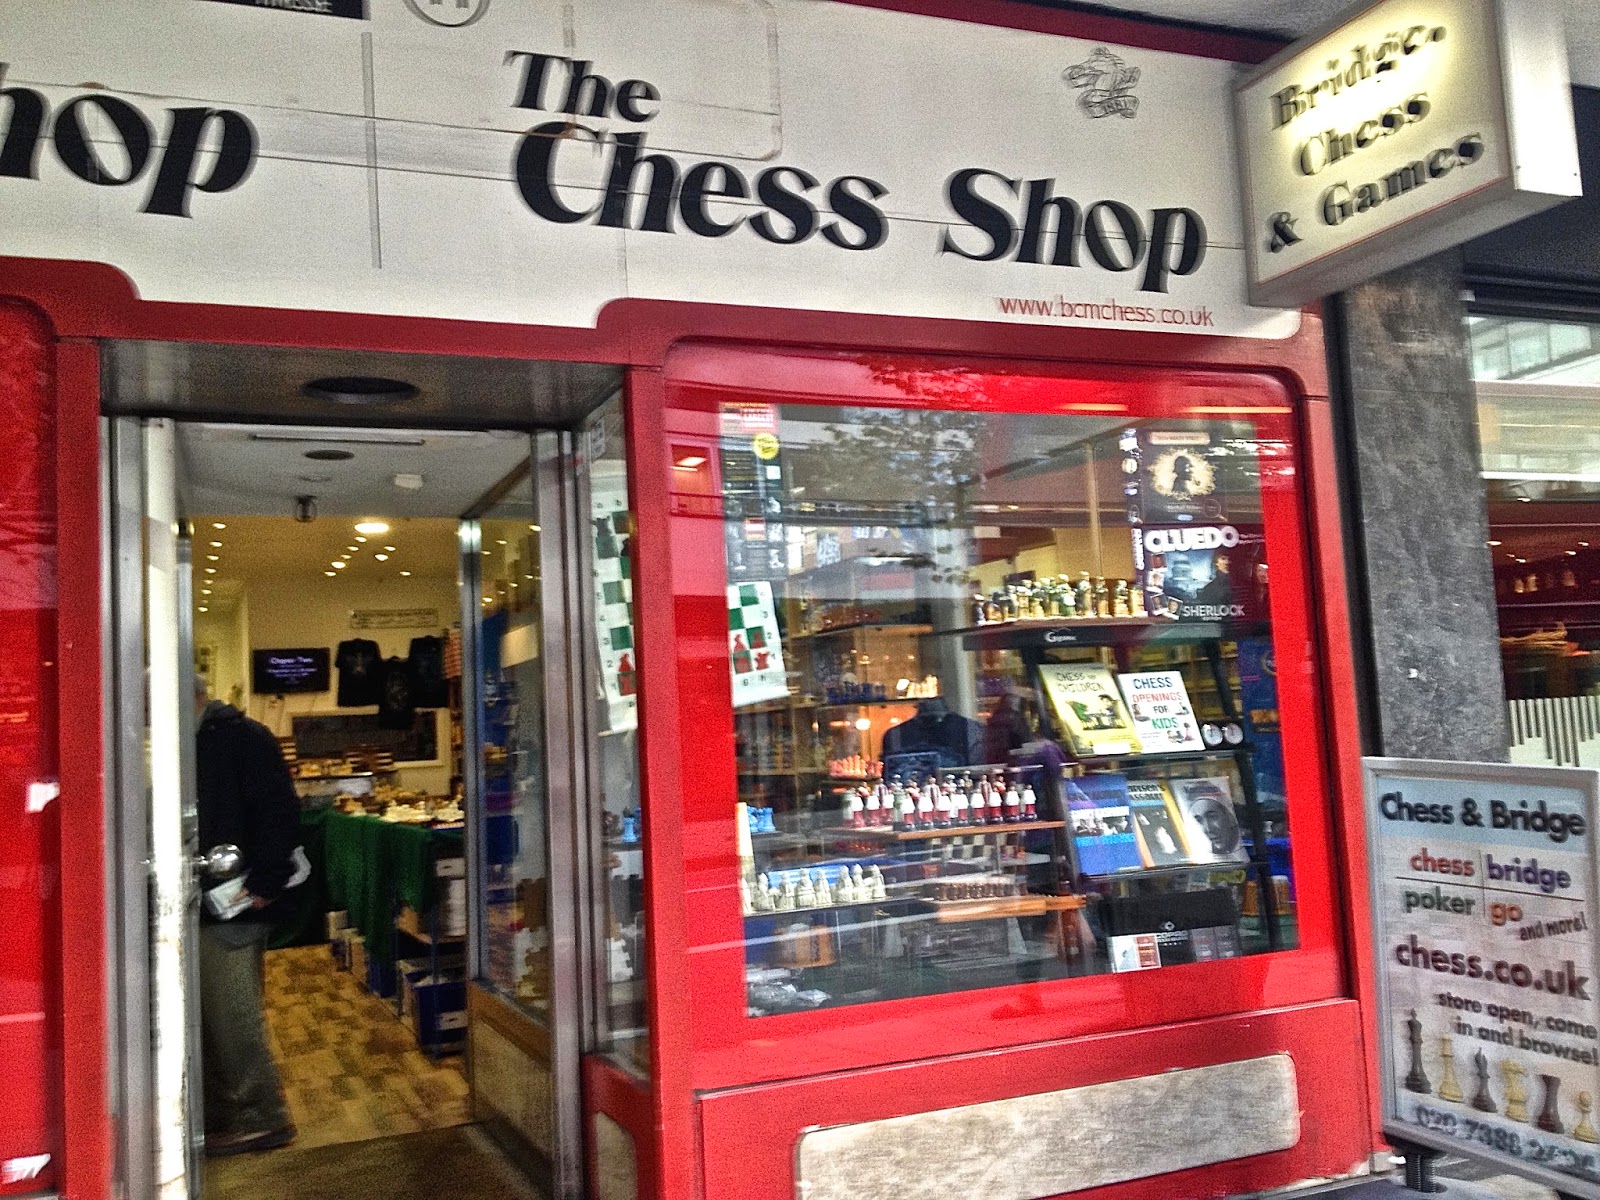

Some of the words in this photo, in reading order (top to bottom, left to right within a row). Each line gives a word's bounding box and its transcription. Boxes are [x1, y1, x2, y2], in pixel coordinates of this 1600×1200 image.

[503, 50, 661, 122] The
[1269, 25, 1447, 131] Bridge
[1293, 92, 1431, 176] Chess
[510, 121, 890, 251] Chess
[936, 168, 1207, 294] Shop
[1267, 211, 1303, 253] &
[1317, 132, 1484, 226] Games
[996, 295, 1214, 327] www.bcmchess.co.uk
[1144, 525, 1239, 553] CLUEDO
[1181, 604, 1245, 617] SHERLOCK
[1056, 672, 1086, 682] CHESS
[1057, 682, 1105, 693] CHILDREN
[1133, 677, 1173, 690] CHESS
[1132, 692, 1183, 703] OPENINGS
[1153, 705, 1169, 714] FOR
[1151, 717, 1179, 729] KIDS
[1380, 791, 1455, 825] Chess
[1460, 797, 1485, 827] &
[1490, 799, 1586, 843] Bridge
[1409, 848, 1475, 877] chess
[1485, 854, 1572, 893] bridge
[1404, 886, 1475, 915] poker
[1489, 902, 1523, 926] go
[1519, 920, 1545, 941] and
[1546, 911, 1588, 937] more!
[1395, 934, 1592, 1001] chess.co.uk
[1436, 991, 1482, 1013] store
[1487, 1003, 1539, 1028] open,
[1545, 1015, 1598, 1039] come
[1453, 1016, 1473, 1036] in
[1478, 1026, 1514, 1046] and
[1519, 1028, 1599, 1066] browse!
